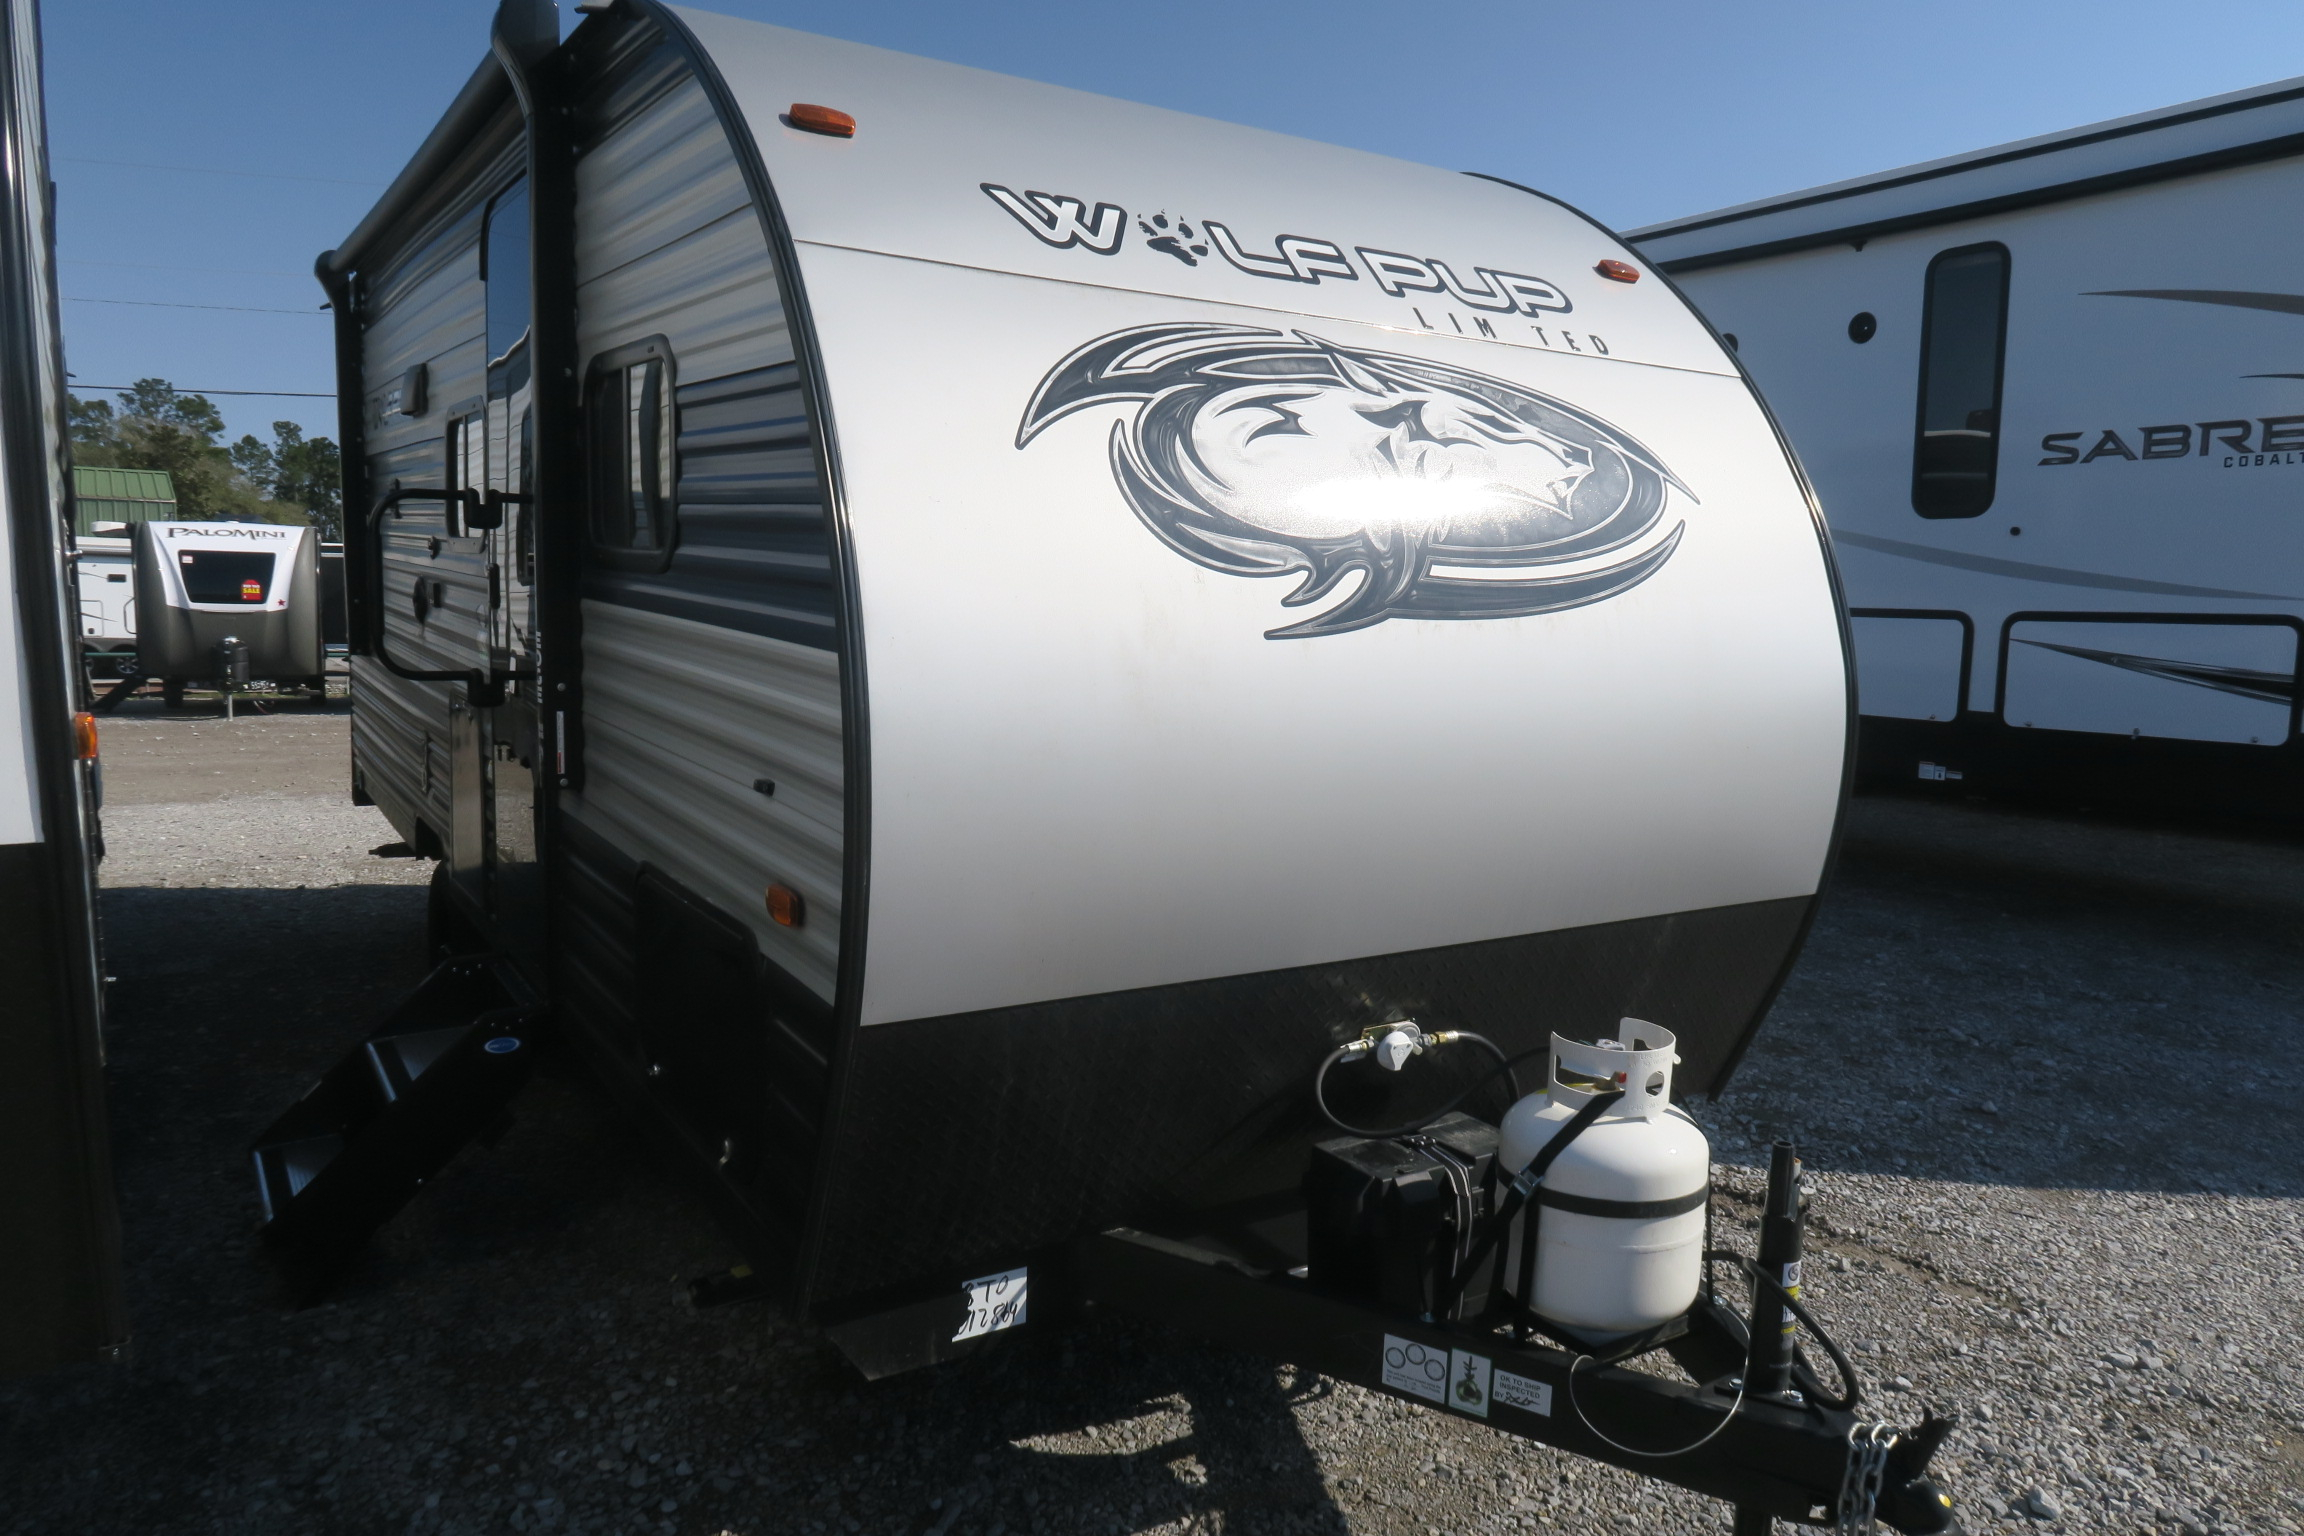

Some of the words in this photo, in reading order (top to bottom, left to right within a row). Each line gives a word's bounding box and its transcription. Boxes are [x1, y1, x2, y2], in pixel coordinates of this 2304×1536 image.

[1355, 245, 1574, 318] PUP
[1412, 306, 1609, 356] LIMTED
[2037, 415, 2304, 467] SABRE
[1494, 1390, 1505, 1399] BY
[1500, 1374, 1511, 1384] OK
[1513, 1377, 1523, 1387] TO
[1524, 1381, 1541, 1392] SHIP
[1500, 1381, 1540, 1399] INSPECTED
